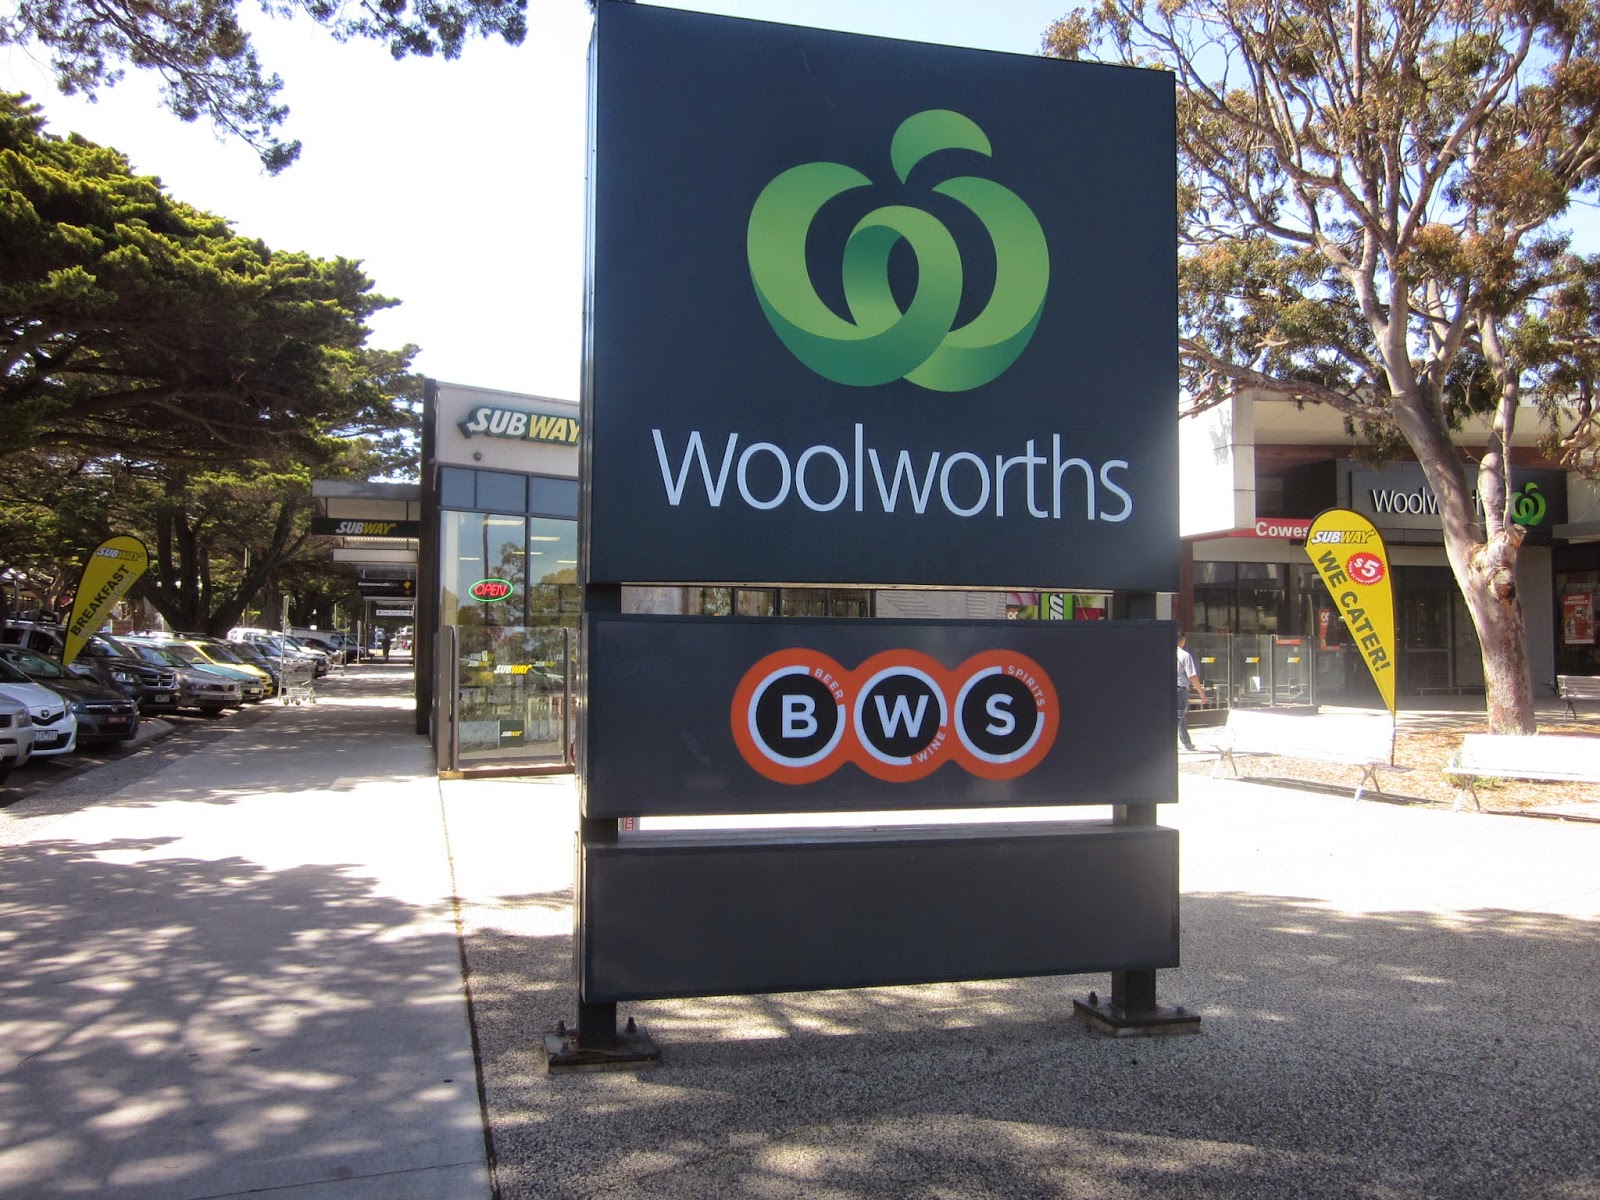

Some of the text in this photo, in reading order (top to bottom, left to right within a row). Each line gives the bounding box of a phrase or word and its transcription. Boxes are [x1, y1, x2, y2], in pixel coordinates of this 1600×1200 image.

[466, 407, 580, 443] SUBWAY
[650, 422, 1134, 523] Woolworths
[335, 521, 397, 535] SUBWAY
[1310, 529, 1376, 545] SUBWAY
[96, 547, 144, 561] SUBWAY
[1354, 557, 1379, 578] $5
[70, 564, 129, 636] BREAKFAST
[473, 583, 509, 597] OPEN
[1317, 550, 1391, 673] WE CATER!
[493, 664, 534, 675] SUBWAY
[813, 667, 844, 700] BEER
[1006, 665, 1046, 707] SPIRITS
[915, 729, 947, 763] WINE
